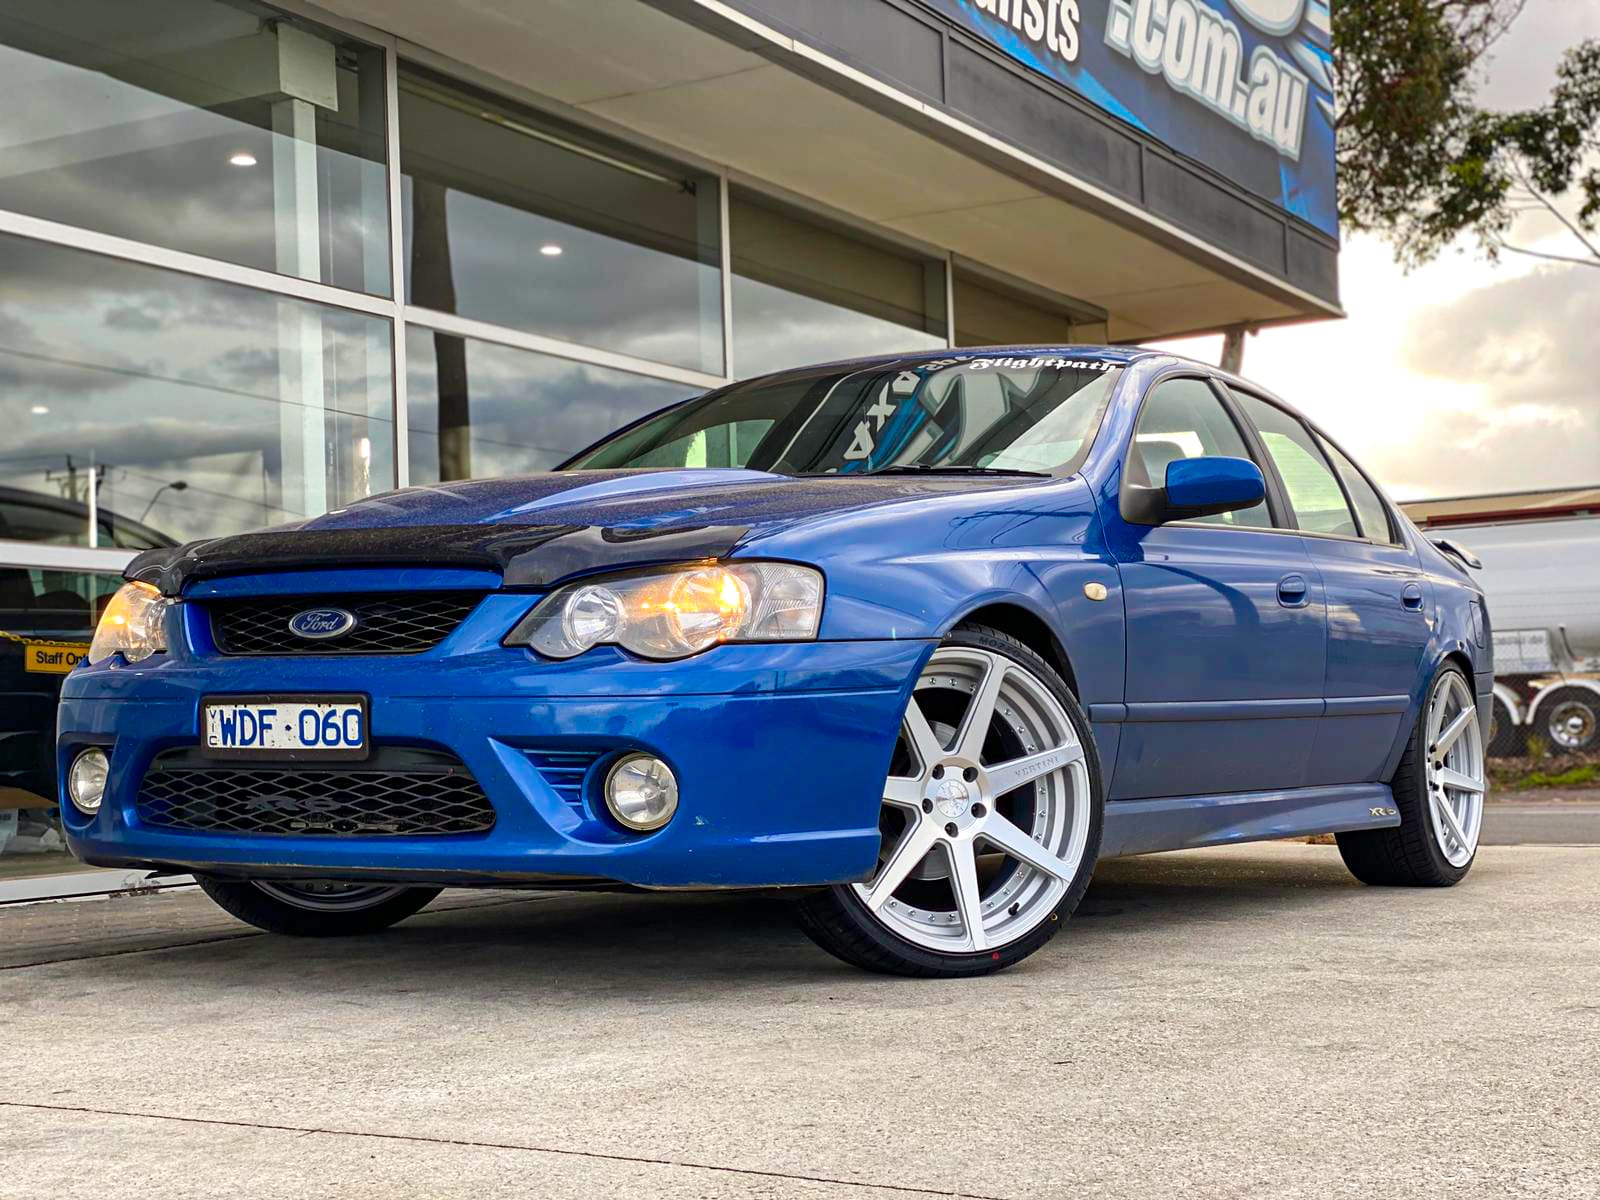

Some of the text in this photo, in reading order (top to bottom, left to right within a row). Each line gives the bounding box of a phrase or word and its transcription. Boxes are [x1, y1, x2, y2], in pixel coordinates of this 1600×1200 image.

[1107, 0, 1304, 155] .com.au
[301, 613, 338, 632] Ford
[36, 651, 87, 665] Staff On
[209, 710, 218, 746] VIC
[219, 708, 363, 746] WDF 060
